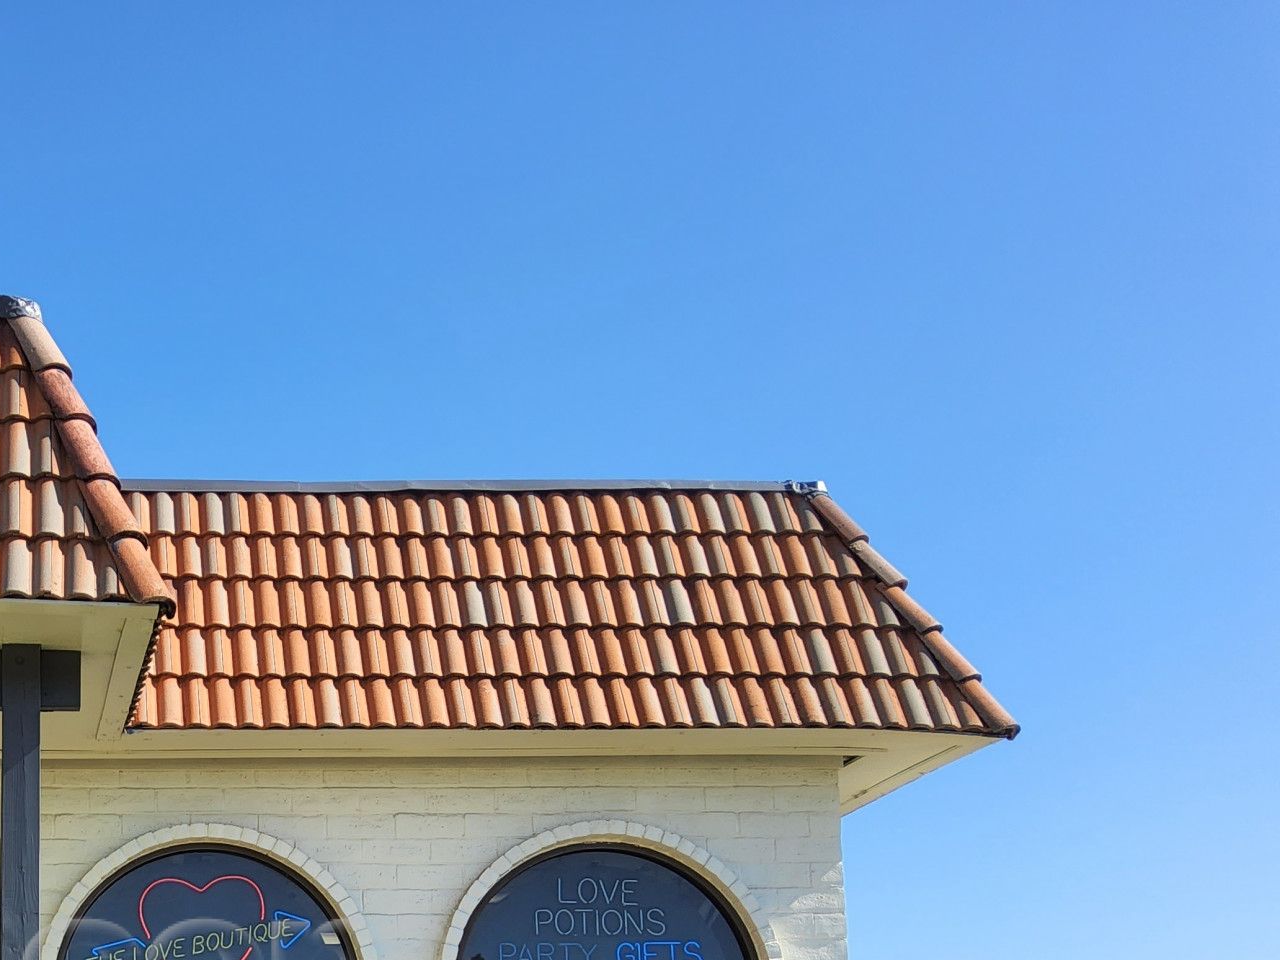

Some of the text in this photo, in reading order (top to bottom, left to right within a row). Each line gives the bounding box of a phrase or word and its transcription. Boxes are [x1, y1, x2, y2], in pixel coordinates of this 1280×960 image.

[557, 877, 639, 906] LOVE
[534, 908, 666, 936] POTIONS
[192, 918, 294, 956] BOUTIQUE
